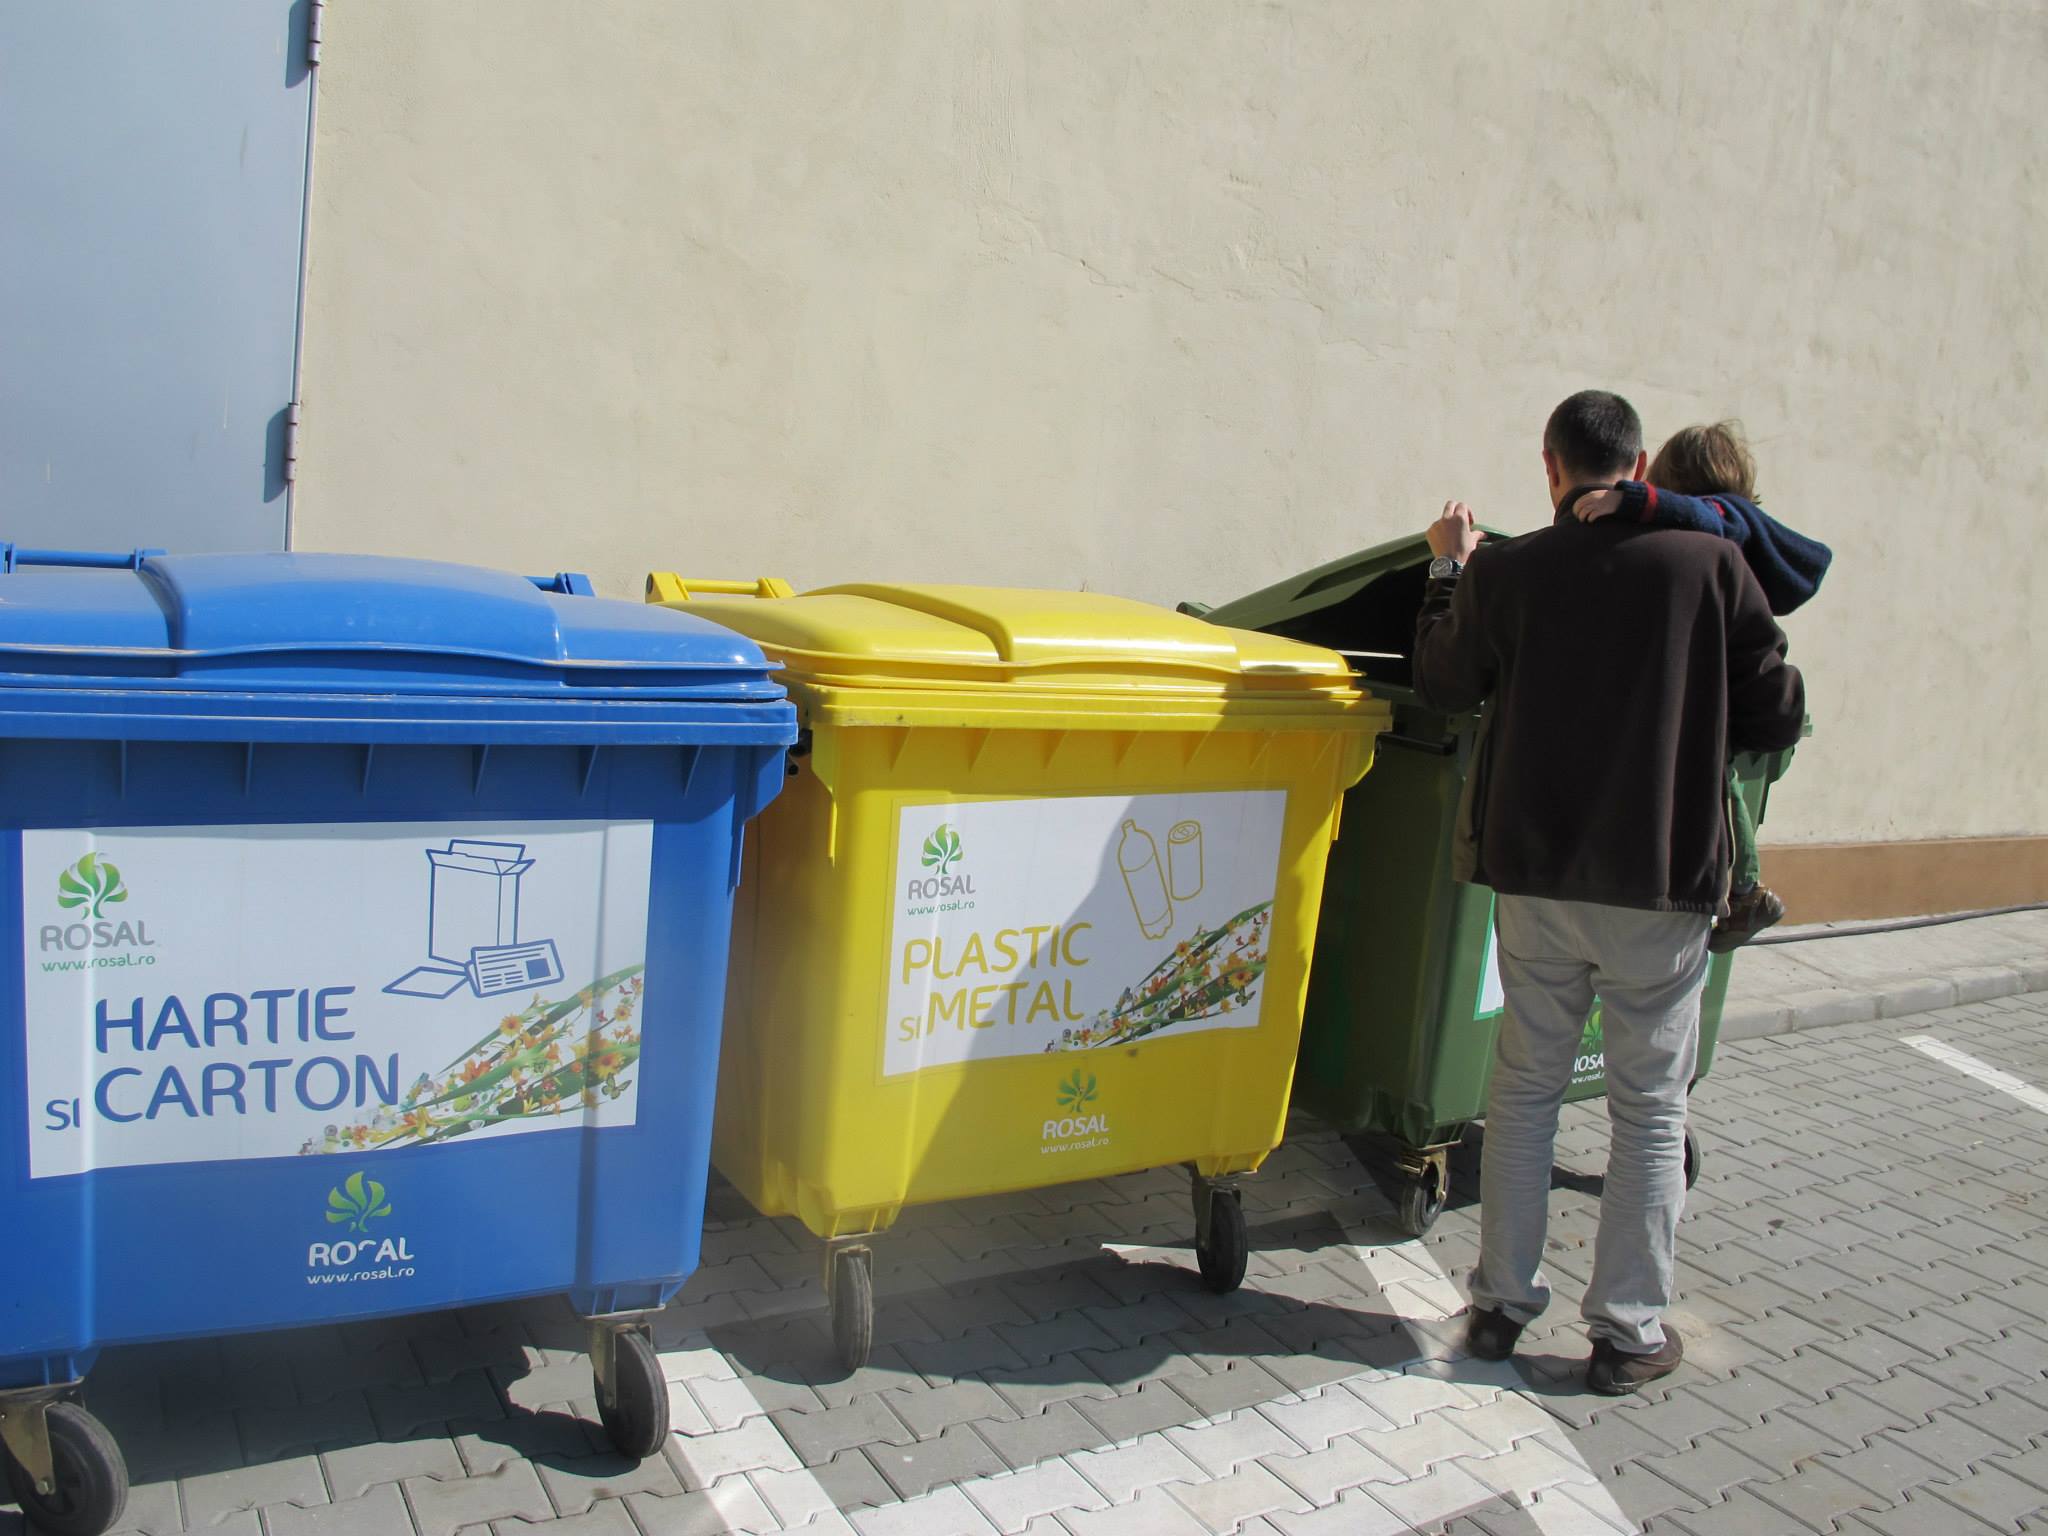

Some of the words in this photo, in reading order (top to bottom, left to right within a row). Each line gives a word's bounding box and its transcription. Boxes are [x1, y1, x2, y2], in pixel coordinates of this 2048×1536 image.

[908, 874, 976, 900] ROSAL
[40, 920, 155, 952] ROSAL
[41, 953, 156, 972] www.rosal.ro
[902, 922, 1092, 984] PLASTIC
[95, 987, 355, 1053] HARTIE
[927, 979, 1085, 1035] METAL
[1573, 1053, 1605, 1072] OSA
[95, 1054, 399, 1122] CARTON
[1043, 1114, 1109, 1139] ROSAL
[306, 1266, 415, 1284] www.rosal.ro
